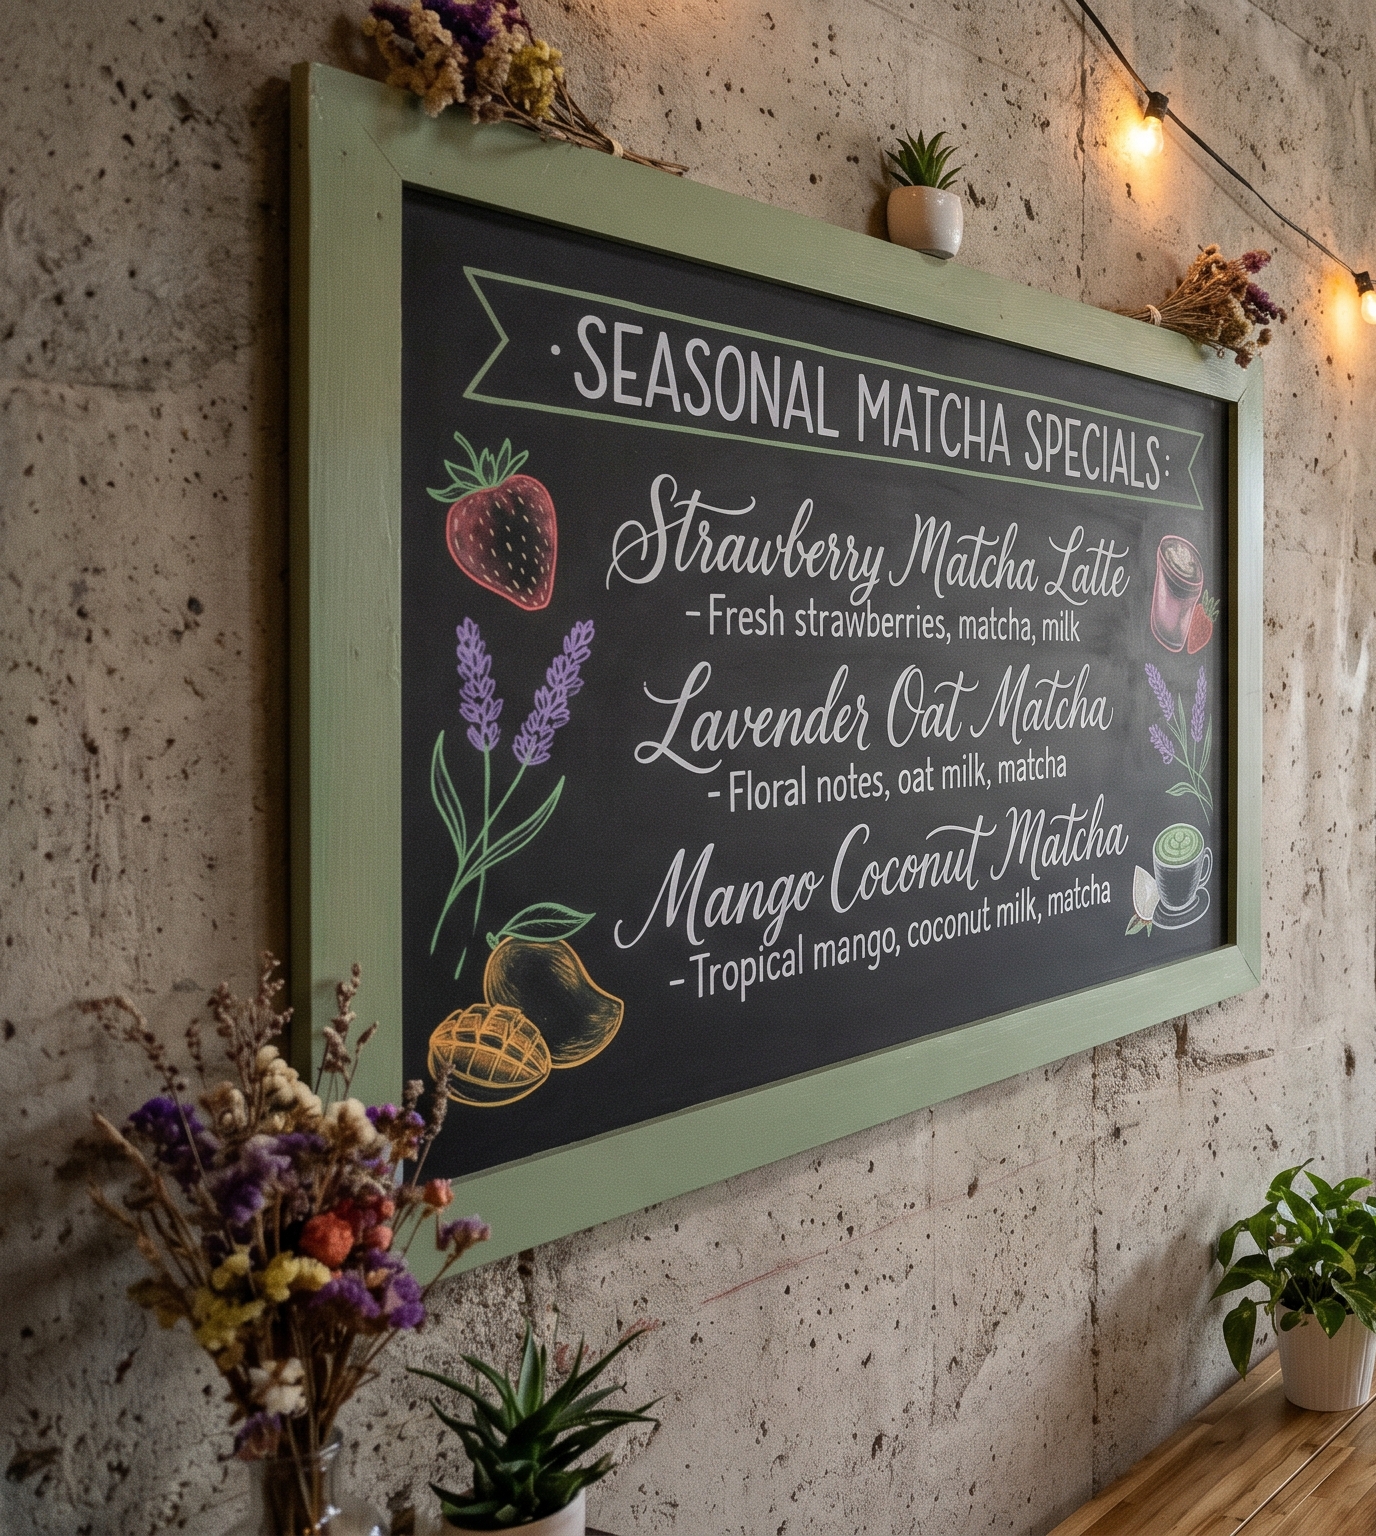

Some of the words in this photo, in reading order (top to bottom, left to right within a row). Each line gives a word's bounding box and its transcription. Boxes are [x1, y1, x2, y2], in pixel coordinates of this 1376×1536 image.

[858, 374, 1012, 467] MATCHA
[606, 473, 884, 606] Strawberry
[888, 513, 1040, 599] Matcha
[1045, 525, 1131, 605] Latte
[795, 594, 951, 645] strawberries,
[958, 607, 1036, 645] matcha,
[1042, 610, 1081, 643] milk
[634, 661, 871, 774] Lavender
[887, 664, 979, 748] Oat
[970, 663, 1114, 745] Matcha
[817, 762, 891, 803] notes,
[898, 756, 934, 794] oat
[942, 752, 991, 790] milk,
[998, 745, 1068, 784] matcha
[614, 842, 825, 948] Mango
[831, 813, 997, 913] Coconut
[990, 793, 1129, 882] Matcha
[814, 926, 901, 971] mango,
[907, 897, 991, 948] coconut
[997, 886, 1043, 929] milk,
[1048, 873, 1111, 916] matcha
